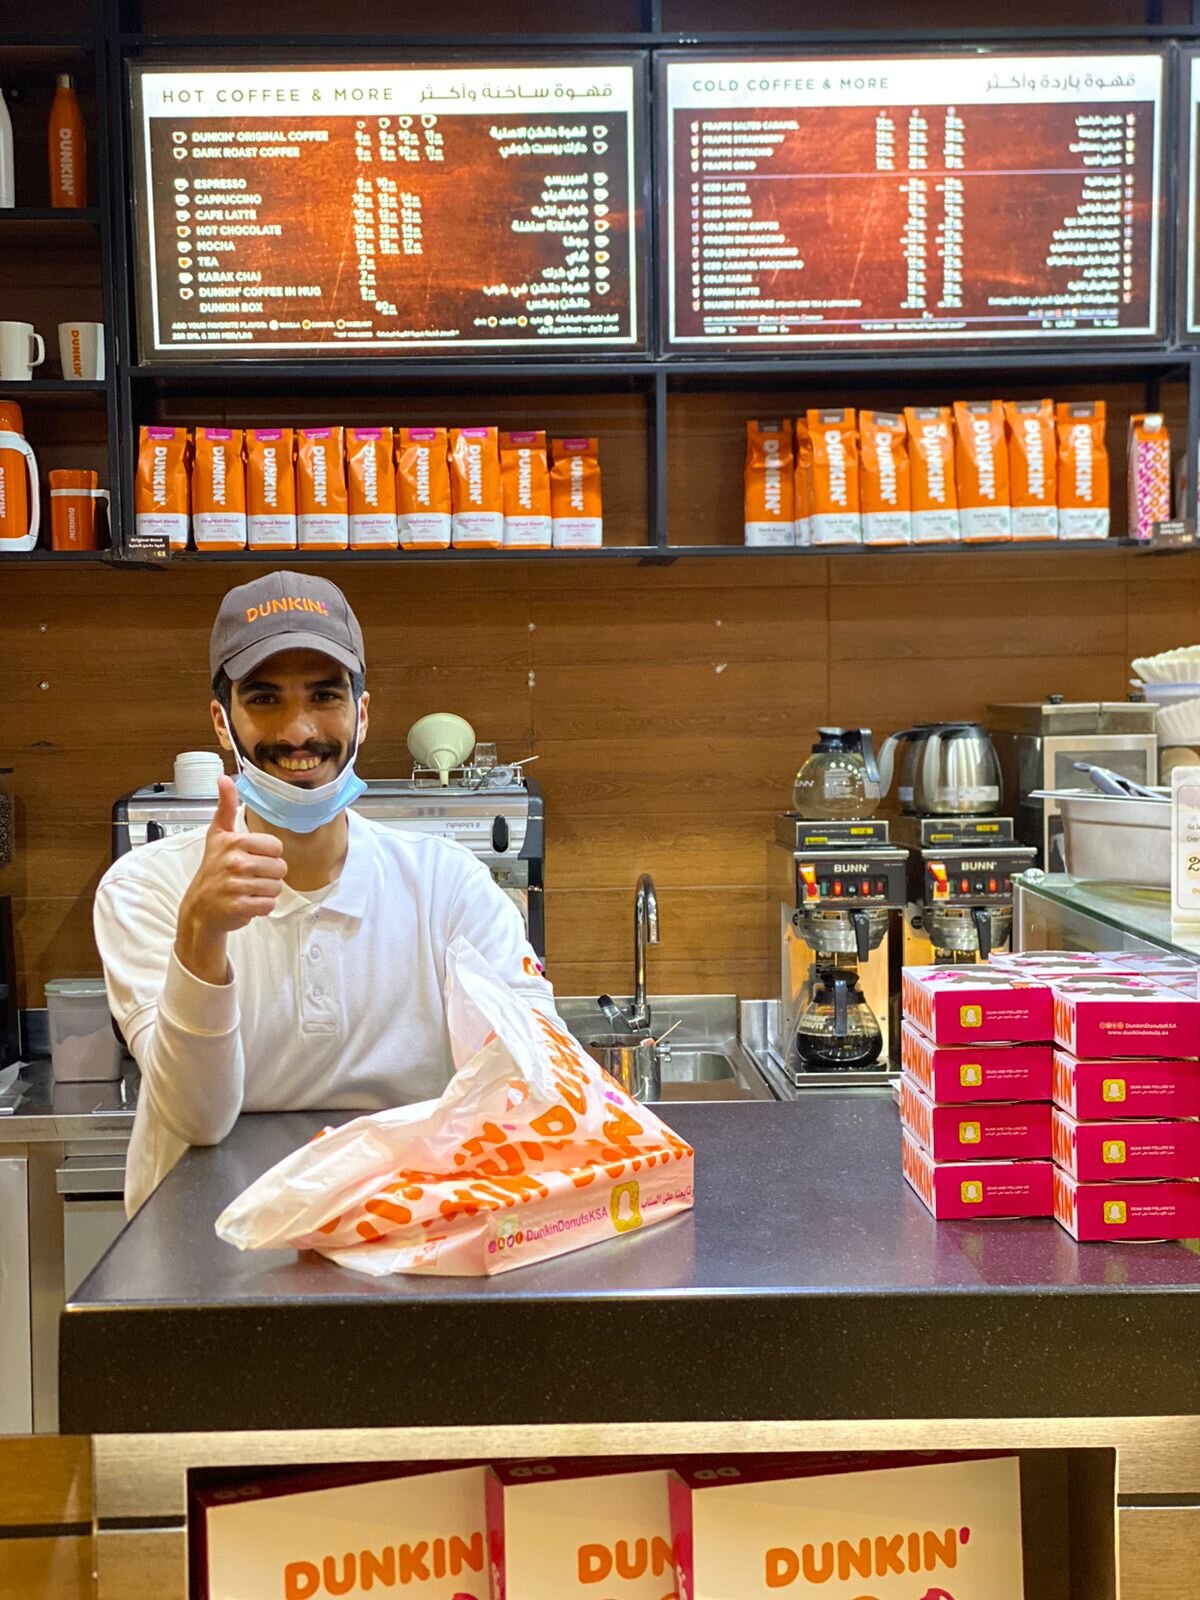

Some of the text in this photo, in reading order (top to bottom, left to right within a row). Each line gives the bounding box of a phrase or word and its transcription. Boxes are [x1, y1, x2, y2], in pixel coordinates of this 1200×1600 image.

[163, 88, 393, 103] HOT COFFEE & MORE
[420, 82, 613, 103] قهوة ساخنة وأكثر
[692, 77, 889, 92] COLD COFFEE & MORE
[985, 72, 1136, 93] قهوة باردة وأكثر
[192, 130, 329, 142] DUNKIN' ORIGINAL COFFEE
[58, 128, 74, 196] DUNKIN'
[192, 146, 300, 158] DARK ROAST COFFEE
[194, 178, 247, 190] ESPRESSO
[194, 194, 262, 205] CAPPUCCINO
[195, 210, 257, 220] CAFE LATTE
[196, 225, 282, 236] HOT CHOCOLATE
[196, 241, 236, 252] MOCHA
[197, 257, 218, 267] TEA
[198, 272, 262, 282] KARAK CHAI
[199, 286, 322, 298] DUNKIN' COFFEE IN MUG
[200, 302, 264, 313] DUNKIN BOX
[468, 444, 482, 506] DUNKIN'
[824, 430, 847, 507] DUNKIN'
[875, 432, 897, 505] DUNKIN'
[973, 420, 996, 500] DUNKIN'
[1024, 419, 1045, 500] DUNKIN'
[1073, 424, 1092, 502] DUNKIN'
[152, 446, 168, 506] DUNKIN'
[212, 446, 226, 506] DUNKIN'
[264, 447, 278, 508] DUNKIN'
[312, 446, 328, 507] DUNKIN'
[364, 445, 378, 506] DUNKIN'
[416, 447, 430, 506] DUNKIN'
[518, 448, 532, 509] DUNKIN'
[245, 596, 326, 623] DUNKIN'
[526, 1206, 608, 1242] DunkinDonutsKSA
[765, 1526, 970, 1588] DUNKIN'
